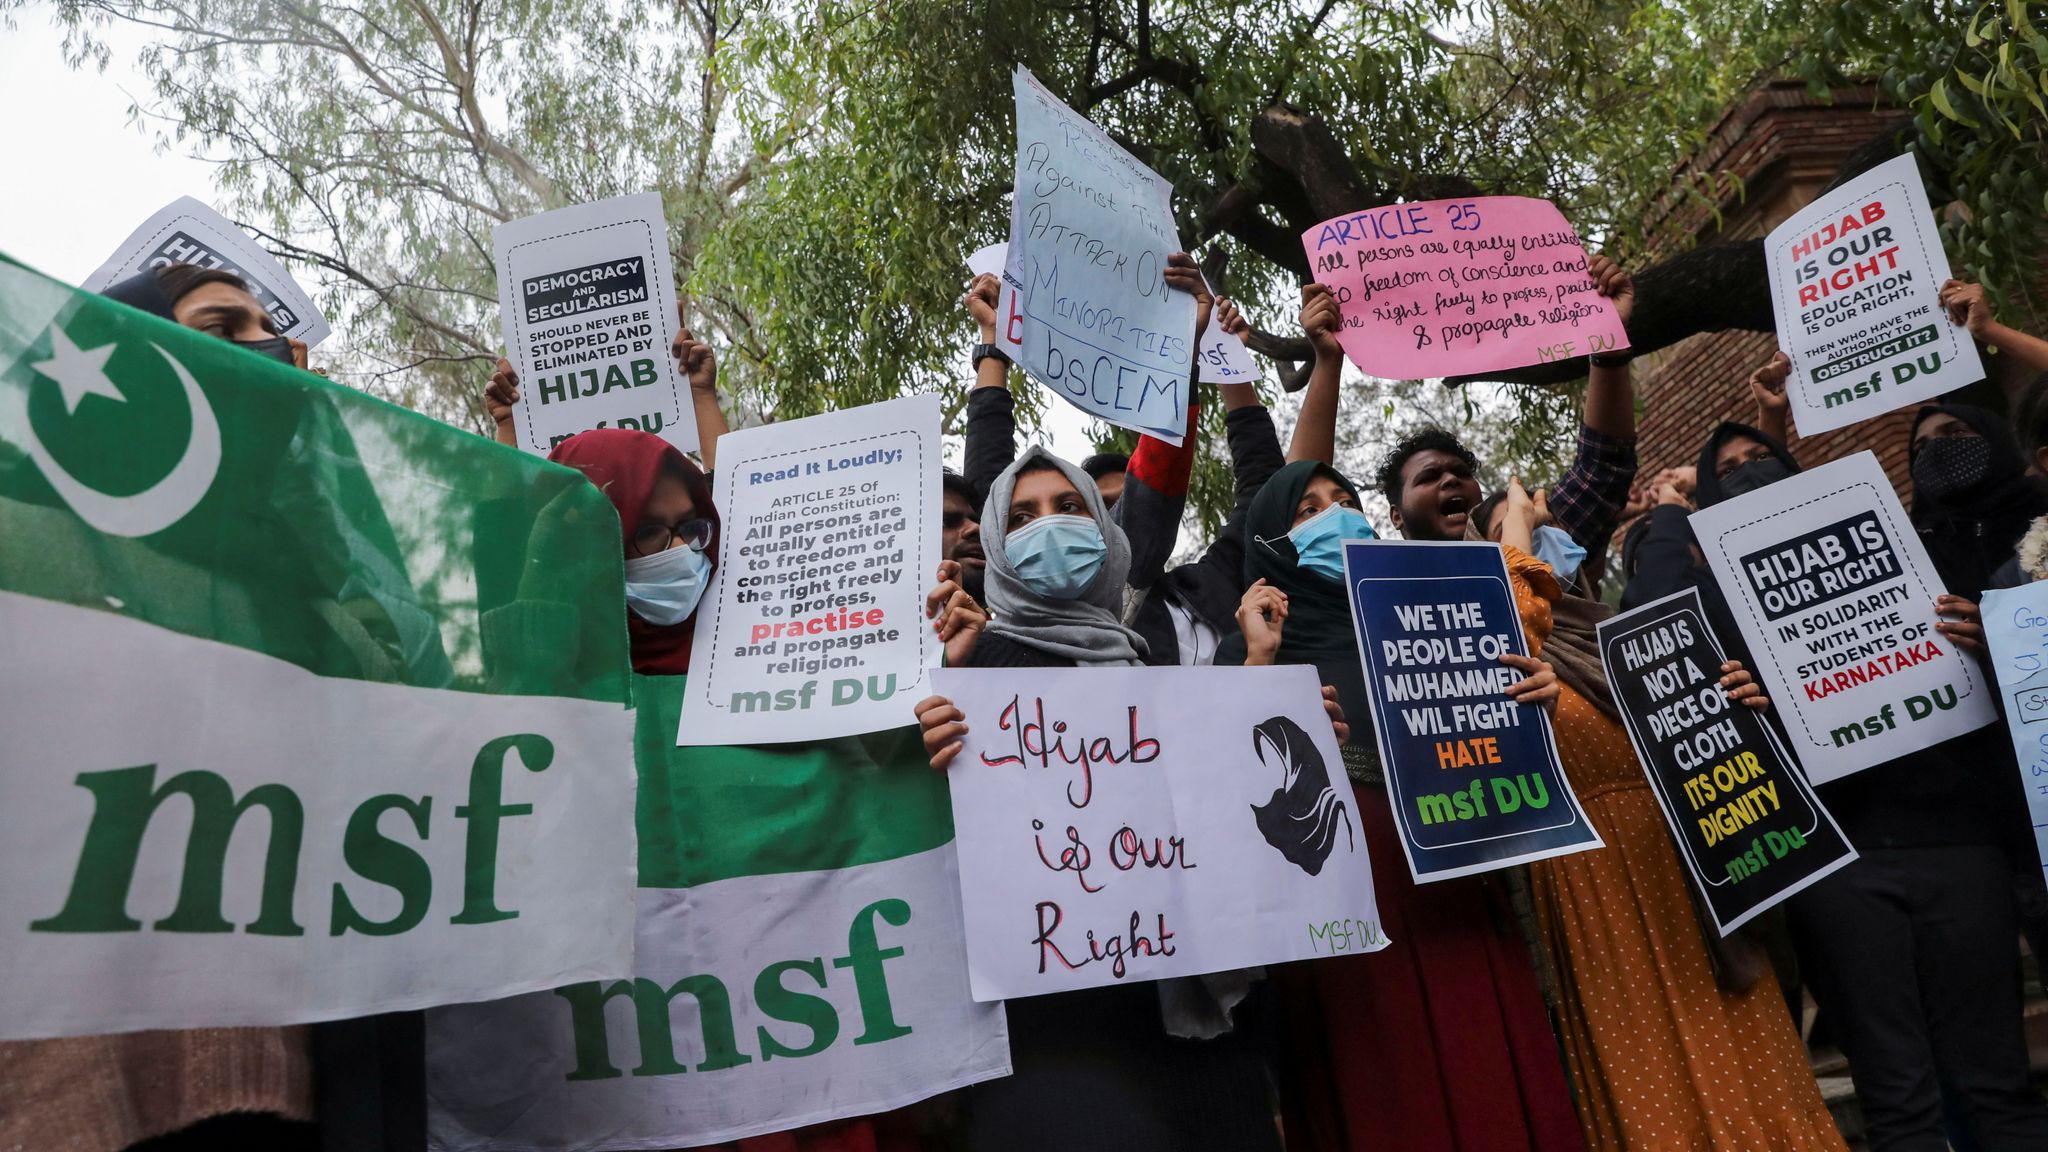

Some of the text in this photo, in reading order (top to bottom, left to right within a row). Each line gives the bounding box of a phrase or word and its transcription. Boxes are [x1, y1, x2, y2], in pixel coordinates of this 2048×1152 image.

[1027, 142, 1117, 212] Against
[1029, 202, 1129, 282] ATTACK
[1317, 204, 1481, 250] ARTICLE 25
[1792, 201, 1886, 263] HIJAB
[1318, 251, 1349, 273] All
[1358, 245, 1415, 272] persons
[1420, 242, 1449, 254] are
[1453, 235, 1515, 261] equally
[1795, 226, 1894, 285] IS OUR
[1798, 246, 1900, 307] RIGHT
[526, 260, 640, 296] DEMOCRACY
[572, 286, 596, 298] AND
[1364, 271, 1433, 301] freedom
[1439, 267, 1460, 288] of
[1462, 262, 1549, 281] conscience
[1553, 255, 1588, 273] and
[1801, 270, 1913, 326] EDUCATION
[528, 286, 645, 322] SECULARISM
[530, 311, 650, 342] SHOULD NEVER BE
[1029, 254, 1189, 366] MINORITIES
[1373, 301, 1428, 326] right
[1482, 290, 1498, 304] to
[1442, 313, 1536, 351] propagate
[1539, 302, 1603, 327] religion
[1806, 288, 1915, 336] IS OUR RIGHT,
[531, 324, 652, 358] STOPPED AND
[534, 339, 653, 371] ELIMINATED BY
[1537, 333, 1616, 363] MSF DU
[1804, 305, 1930, 359] THEN WHO HAVE THE
[1817, 330, 1932, 380] OBSTRUCT IT?
[1827, 323, 1912, 361] AUTHORITY TO
[538, 359, 658, 406] HIJAB
[1823, 352, 1942, 409] msf DU
[750, 449, 902, 485] Read It Loudly;
[750, 493, 900, 525] Indian Constitution:
[771, 481, 879, 508] ARTICLE 25 Of
[739, 518, 906, 558] equally entitled
[745, 506, 902, 540] All persons are
[737, 549, 903, 588] conscience and
[748, 535, 896, 571] to freedom of
[1748, 520, 1885, 591] HIJAB IS
[737, 568, 902, 604] the right freely
[761, 591, 876, 617] to profess,
[1763, 549, 1895, 614] OUR RIGHT
[751, 607, 884, 645] practise
[1393, 602, 1486, 632] WE THE
[1778, 583, 1911, 644] IN SOLIDARITY
[1806, 611, 1904, 655] WITH THE
[734, 628, 899, 657] and propagate
[766, 655, 865, 674] religion.
[1381, 633, 1511, 667] PEOPLE OF
[1620, 618, 1695, 672] HIJAB IS
[1797, 622, 1930, 679] STUDENTS OF
[730, 674, 896, 713] msf DU
[1642, 656, 1707, 703] NOT A
[1803, 640, 1944, 702] KARNATAKA
[1401, 700, 1522, 737] WIL FIGHT
[1647, 681, 1733, 744] PIECE OF
[1829, 683, 1958, 748] msf DU
[1435, 736, 1503, 770] HATE
[1673, 718, 1744, 772] CLOTH
[1416, 772, 1551, 825] msf DU
[1682, 751, 1767, 811] ITS OUR
[28, 733, 556, 938] msf
[1698, 780, 1782, 849] DIGNITY
[1032, 819, 1107, 894] is
[1725, 838, 1771, 886] msf
[1032, 901, 1176, 978] Right
[1308, 918, 1354, 955] MSF
[557, 897, 912, 1083] msf
